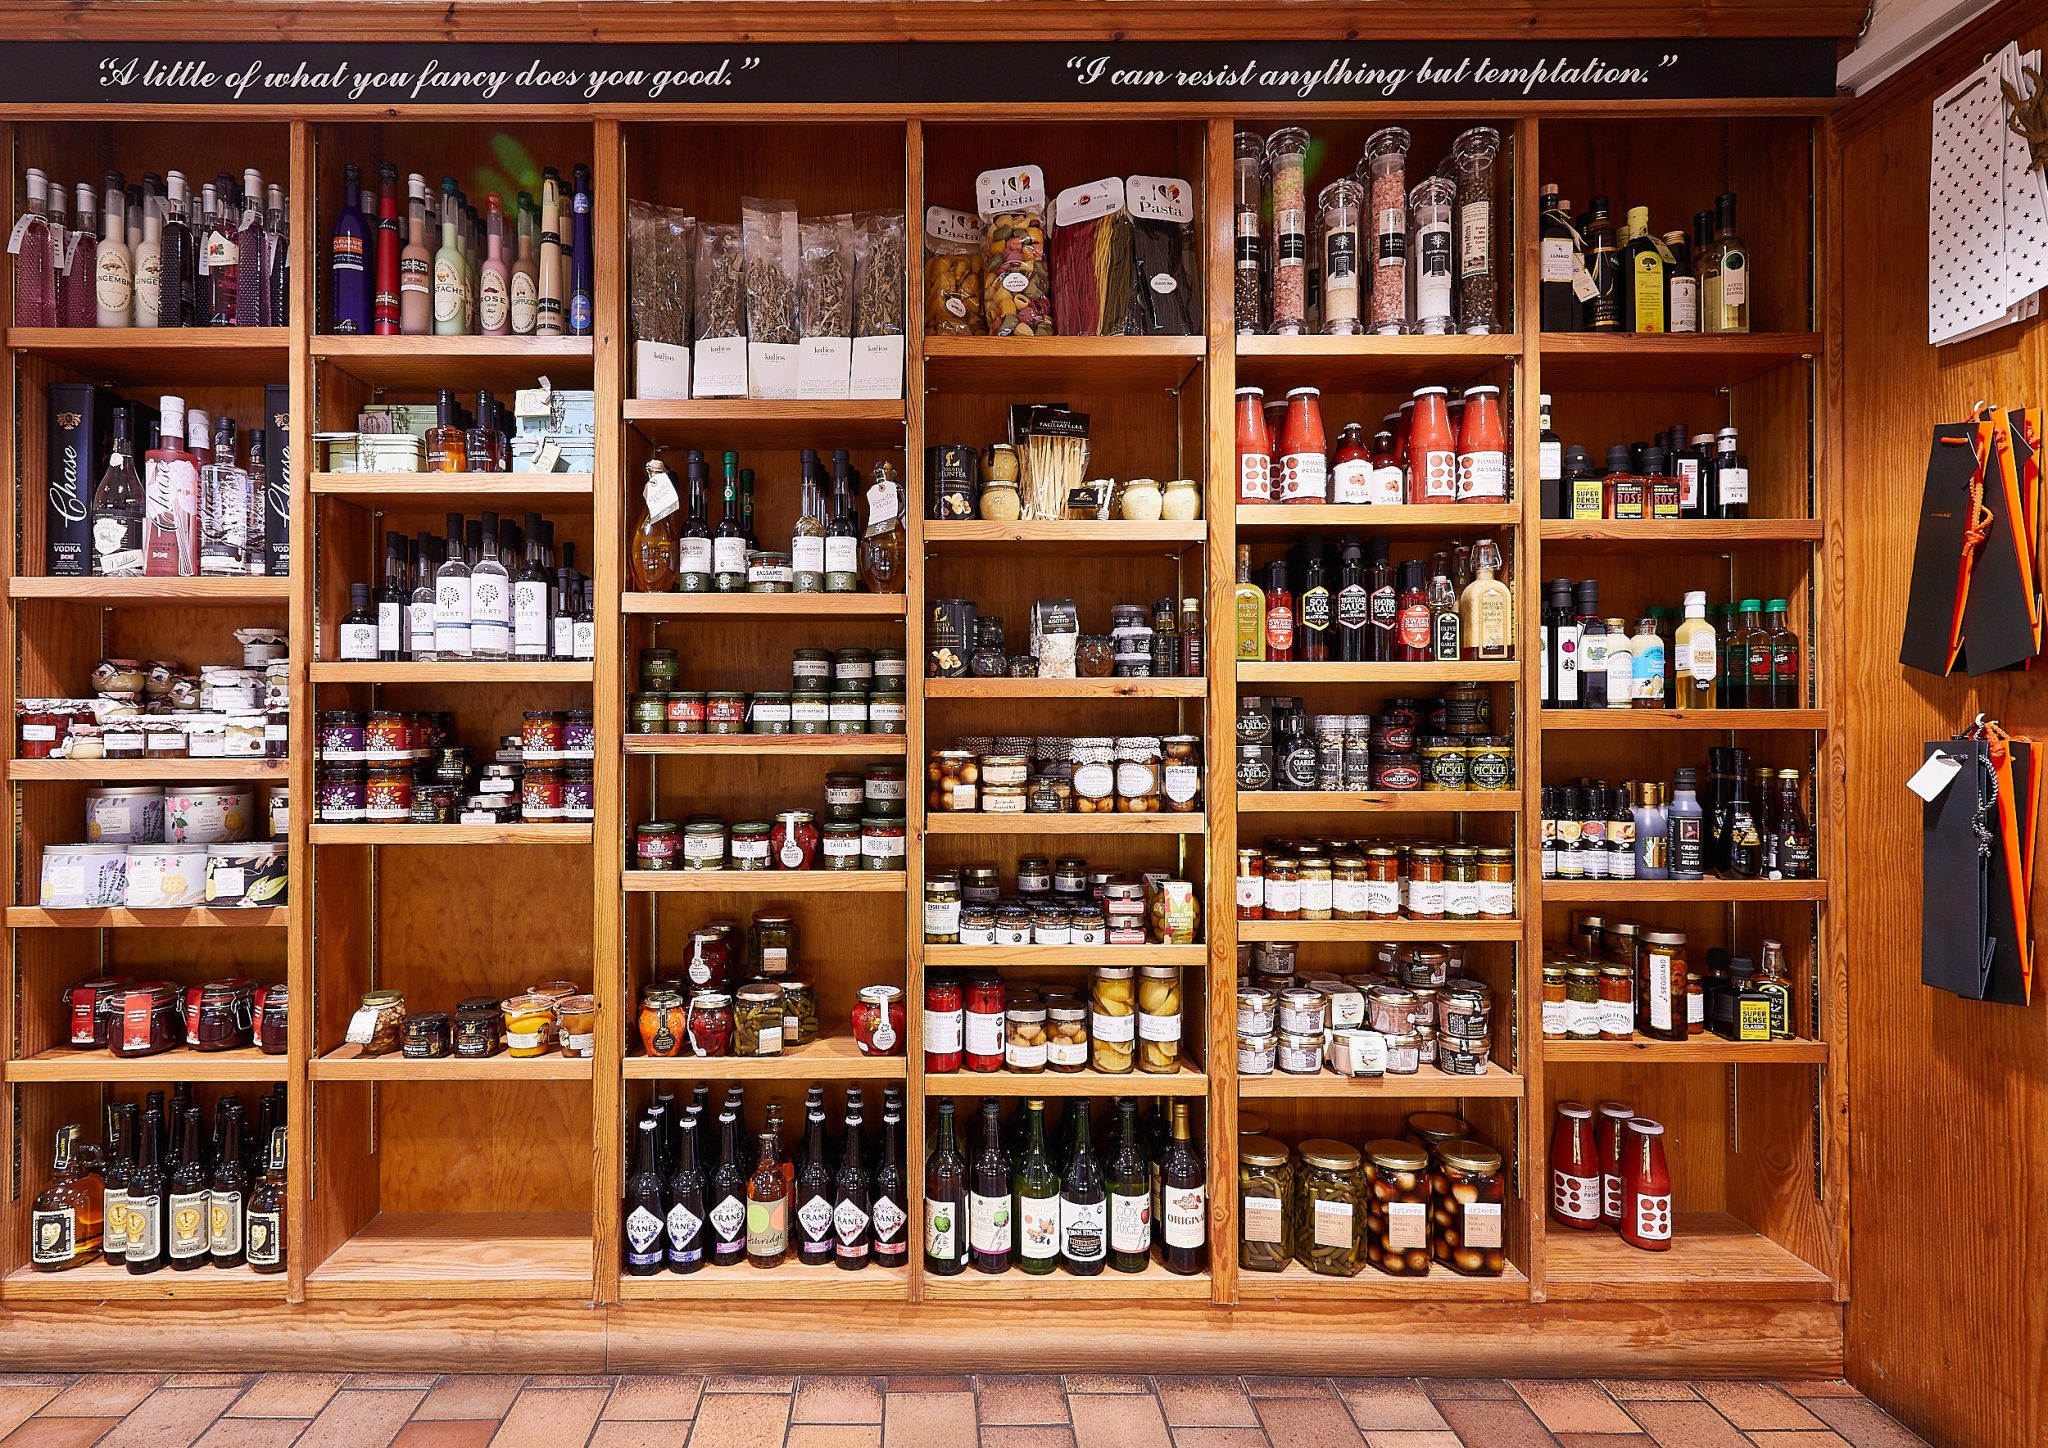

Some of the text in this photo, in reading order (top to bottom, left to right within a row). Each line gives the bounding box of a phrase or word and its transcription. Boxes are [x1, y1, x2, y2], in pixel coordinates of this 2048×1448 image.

[143, 61, 222, 87] little
[225, 61, 262, 99] of
[265, 62, 349, 87] what
[348, 73, 415, 99] you
[410, 60, 513, 98] fancy
[516, 60, 585, 85] does
[584, 71, 651, 98] you
[1112, 70, 1172, 84] can
[1176, 61, 1257, 85] resist
[1259, 58, 1413, 97] anything
[1417, 57, 1471, 83] but
[987, 193, 1034, 210] Pasta
[1139, 200, 1184, 218] Pasta
[936, 225, 980, 242] Pasta
[710, 344, 731, 353] kalios
[813, 345, 835, 354] kalios
[867, 344, 888, 353] kalios
[653, 351, 675, 361] kalios
[764, 352, 786, 361] kalios
[1038, 422, 1083, 431] TAGLIATELLE
[50, 445, 87, 528] Chase
[1345, 490, 1369, 498] SALSA
[1617, 493, 1642, 503] ROSE
[1381, 495, 1402, 503] SALSA
[1654, 494, 1678, 504] ROSE
[1341, 603, 1367, 612] SAUCE
[1237, 722, 1267, 731] GARLIC
[1349, 764, 1369, 772] SALT
[1436, 766, 1466, 775] PICKLE
[1474, 766, 1507, 775] PICKLE
[1237, 770, 1267, 779] GARLIC
[1248, 1201, 1278, 1209] drivers
[1318, 1205, 1348, 1213] drivers
[1115, 1206, 1138, 1217] COX
[801, 1212, 832, 1222] CRANES
[1115, 1217, 1137, 1225] APPLE
[1168, 1214, 1205, 1224] ORIGINA
[1115, 1224, 1139, 1236] JUICE
[175, 1245, 201, 1254] VINTAGE
